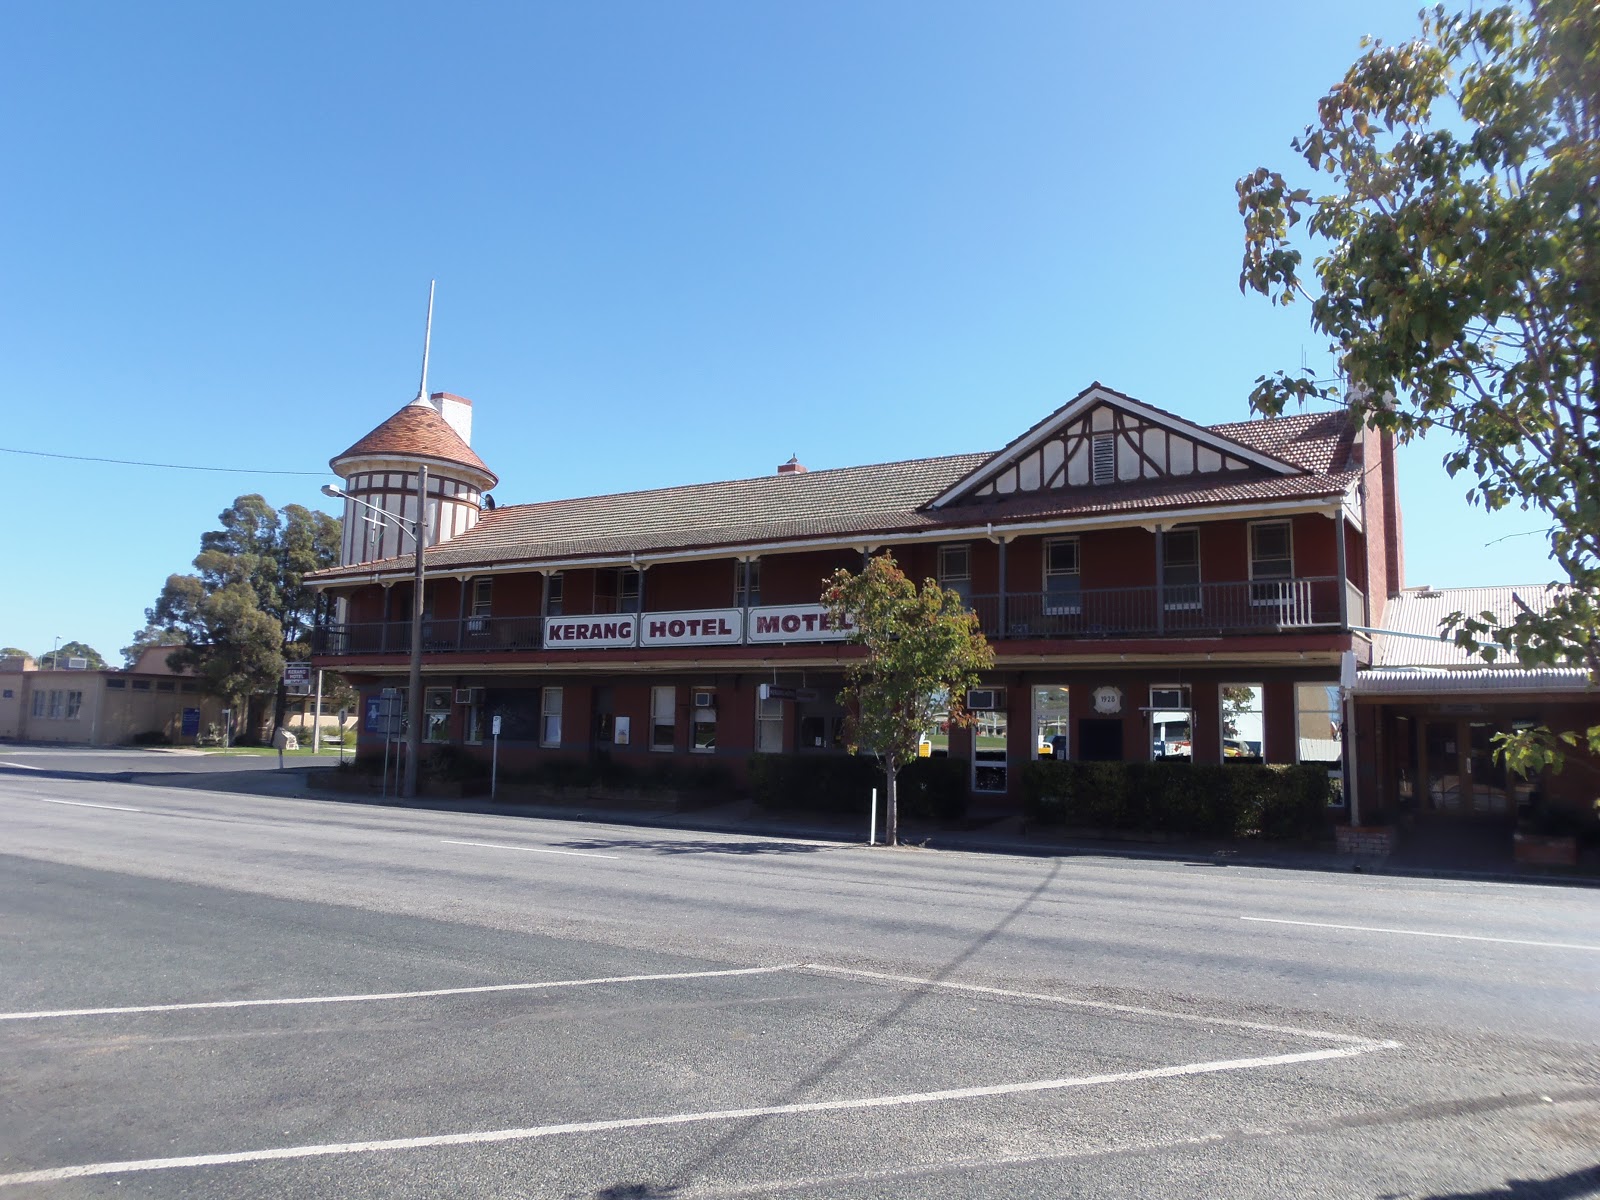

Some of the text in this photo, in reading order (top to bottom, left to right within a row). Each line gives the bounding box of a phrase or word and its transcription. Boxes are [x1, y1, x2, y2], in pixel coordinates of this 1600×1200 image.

[549, 621, 631, 640] KERANG
[649, 618, 732, 638] HOTEL
[1100, 695, 1116, 703] 1928
